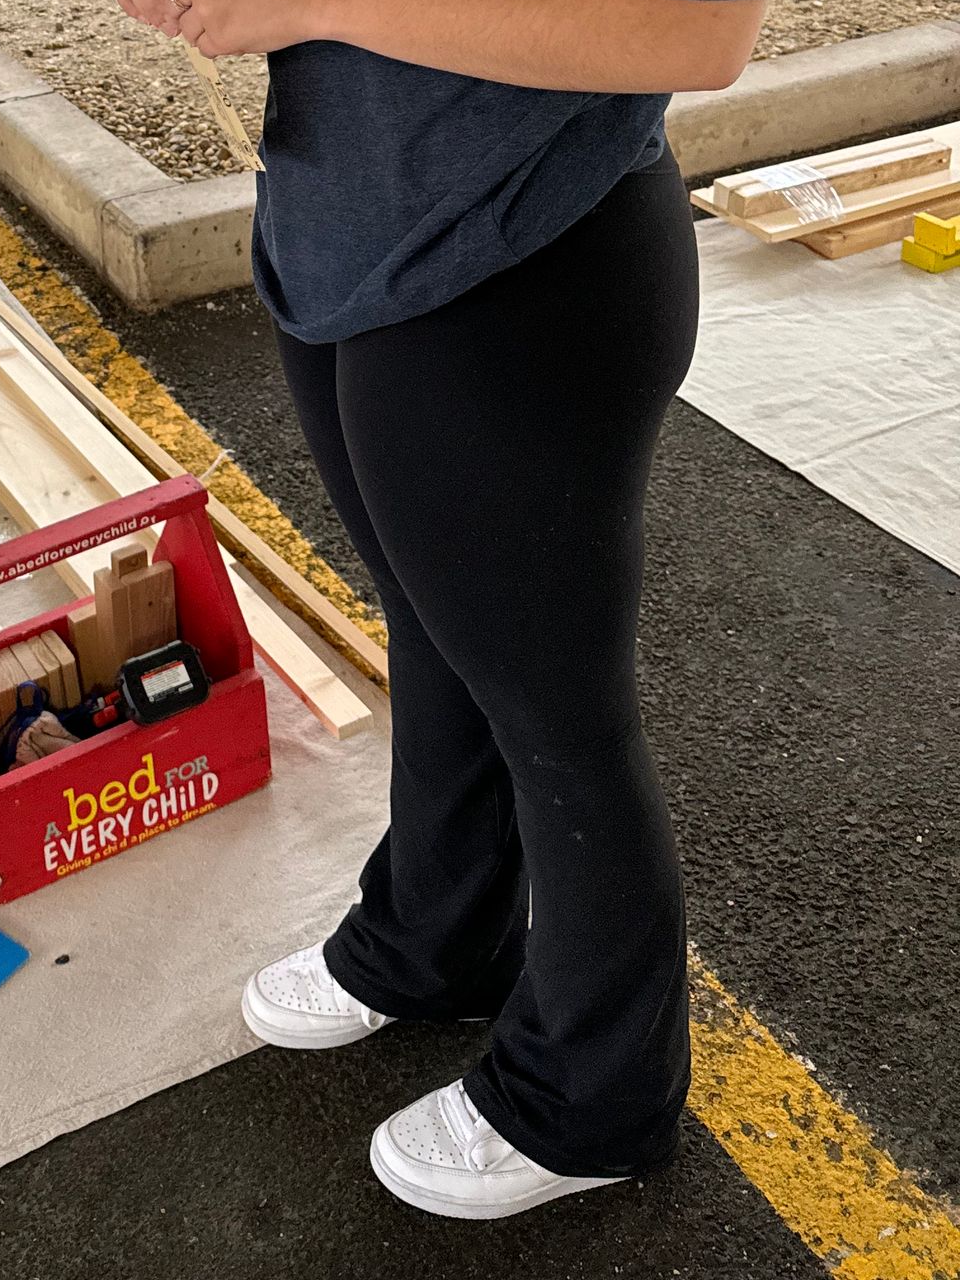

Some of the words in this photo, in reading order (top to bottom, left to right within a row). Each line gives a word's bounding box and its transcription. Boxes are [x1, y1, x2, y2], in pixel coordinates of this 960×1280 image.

[44, 821, 62, 842] A
[63, 752, 161, 831] bed
[164, 755, 209, 788] FOR
[44, 806, 134, 872] EVERY
[56, 855, 92, 876] Giving
[93, 851, 101, 860] a
[130, 835, 137, 844] a
[138, 823, 166, 844] place
[167, 816, 180, 827] to
